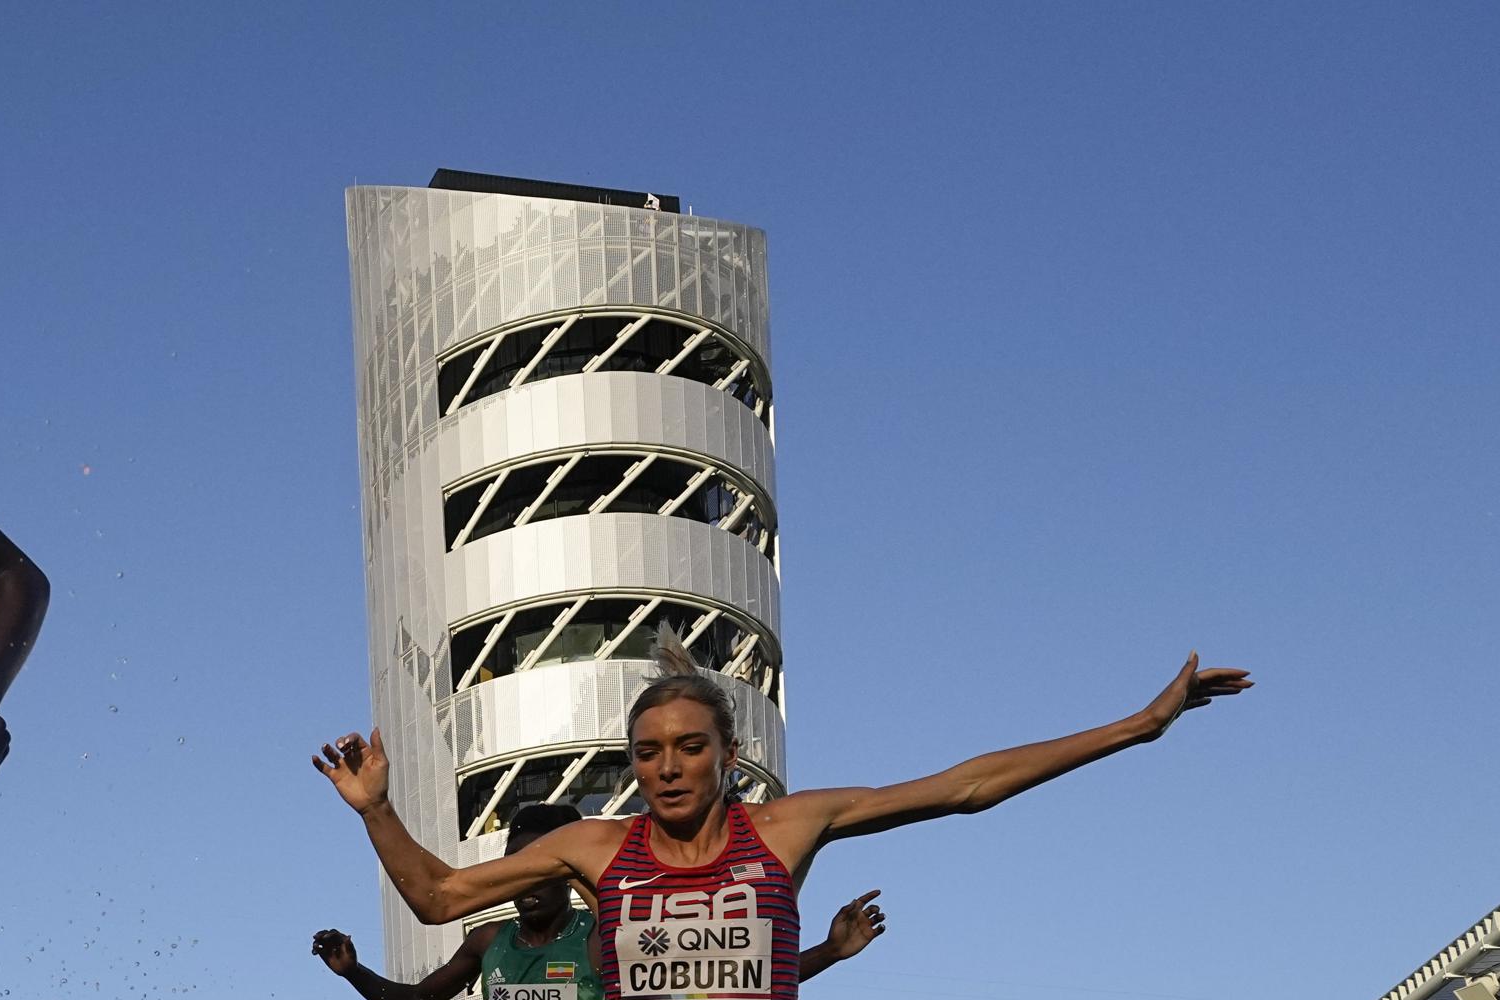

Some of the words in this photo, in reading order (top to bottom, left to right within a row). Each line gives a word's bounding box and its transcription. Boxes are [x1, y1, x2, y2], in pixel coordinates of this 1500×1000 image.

[620, 883, 758, 925] USA
[677, 926, 751, 951] QNB
[629, 959, 763, 991] COBURN
